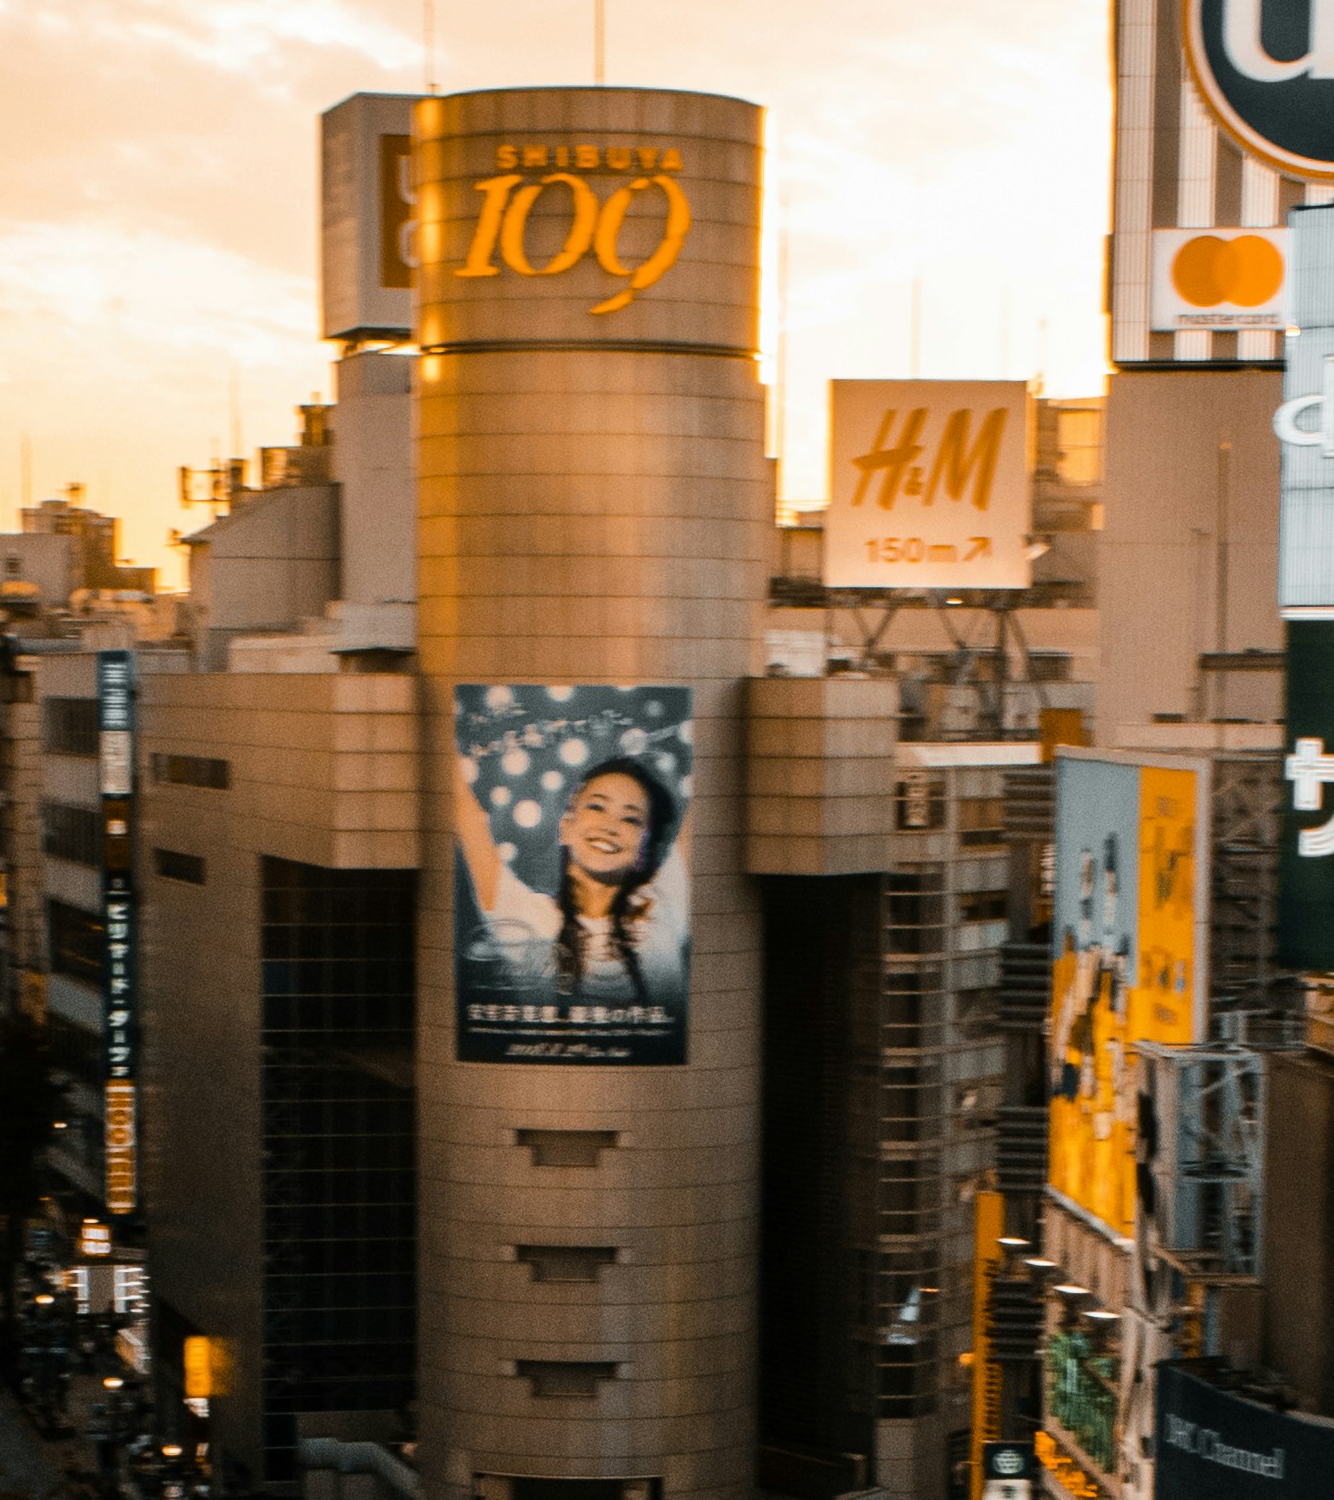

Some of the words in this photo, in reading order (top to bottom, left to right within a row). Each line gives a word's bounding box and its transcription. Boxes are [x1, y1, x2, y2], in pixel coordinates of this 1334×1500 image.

[496, 144, 684, 172] SHIBUYA
[453, 171, 691, 316] 109
[852, 405, 1010, 513] H&M
[864, 535, 958, 564] 150m
